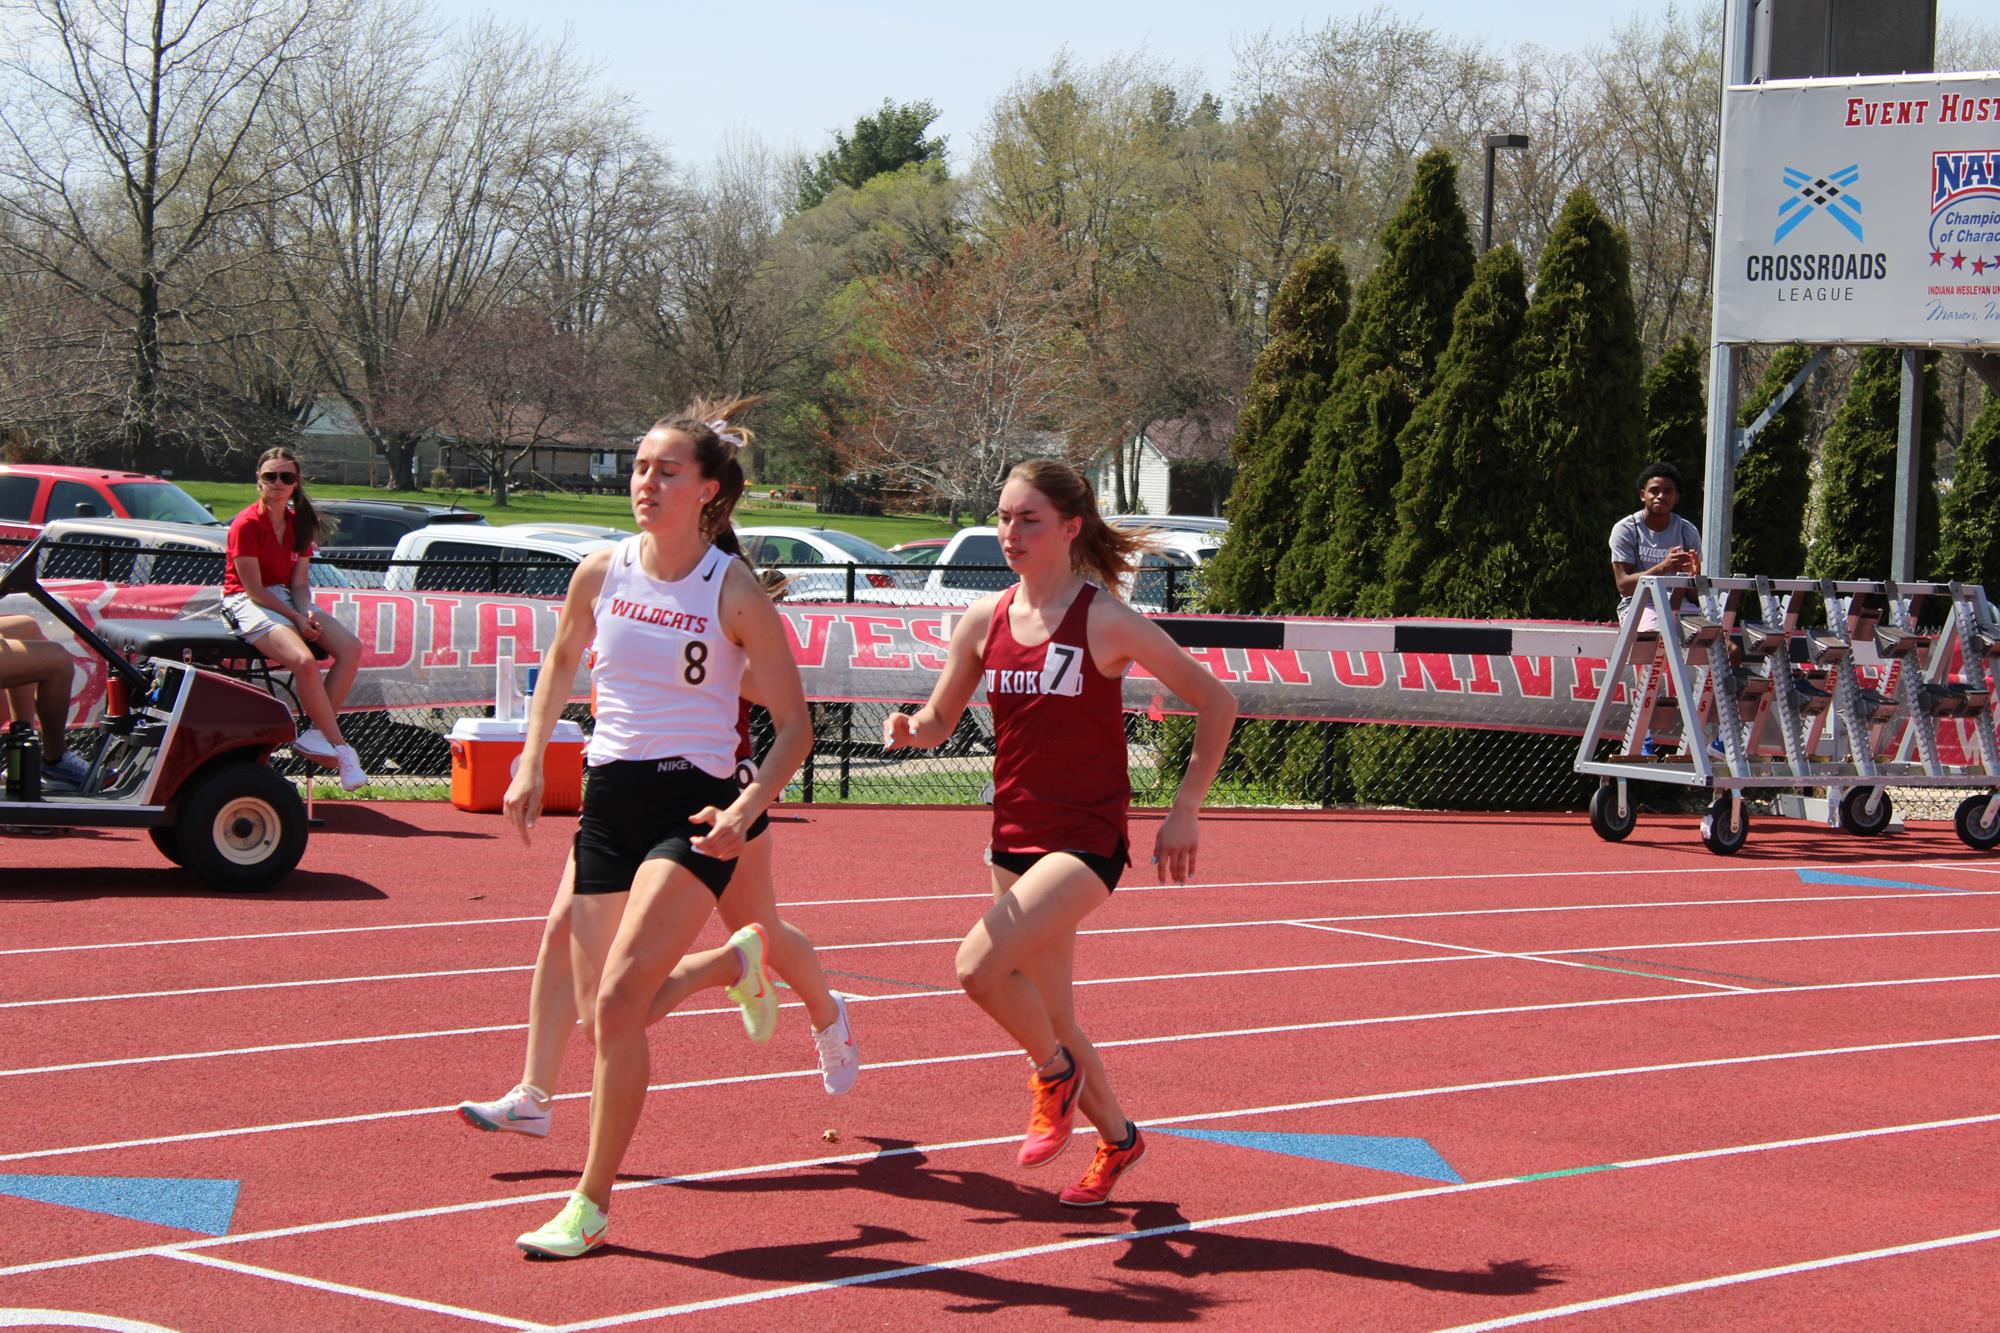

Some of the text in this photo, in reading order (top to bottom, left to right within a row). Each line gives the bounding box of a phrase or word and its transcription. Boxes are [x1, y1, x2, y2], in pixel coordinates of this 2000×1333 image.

[1845, 98, 1929, 126] EVENT
[1940, 230, 1954, 242] of
[1746, 253, 1887, 281] CROSSROADS
[1778, 287, 1853, 301] LEAGUE
[1928, 286, 1954, 295] INDIANA
[1956, 286, 1991, 295] WESLEYAN
[611, 598, 708, 634] WILDCATS
[684, 640, 708, 686] 8
[1049, 647, 1075, 691] 7
[657, 761, 688, 772] NIKE
